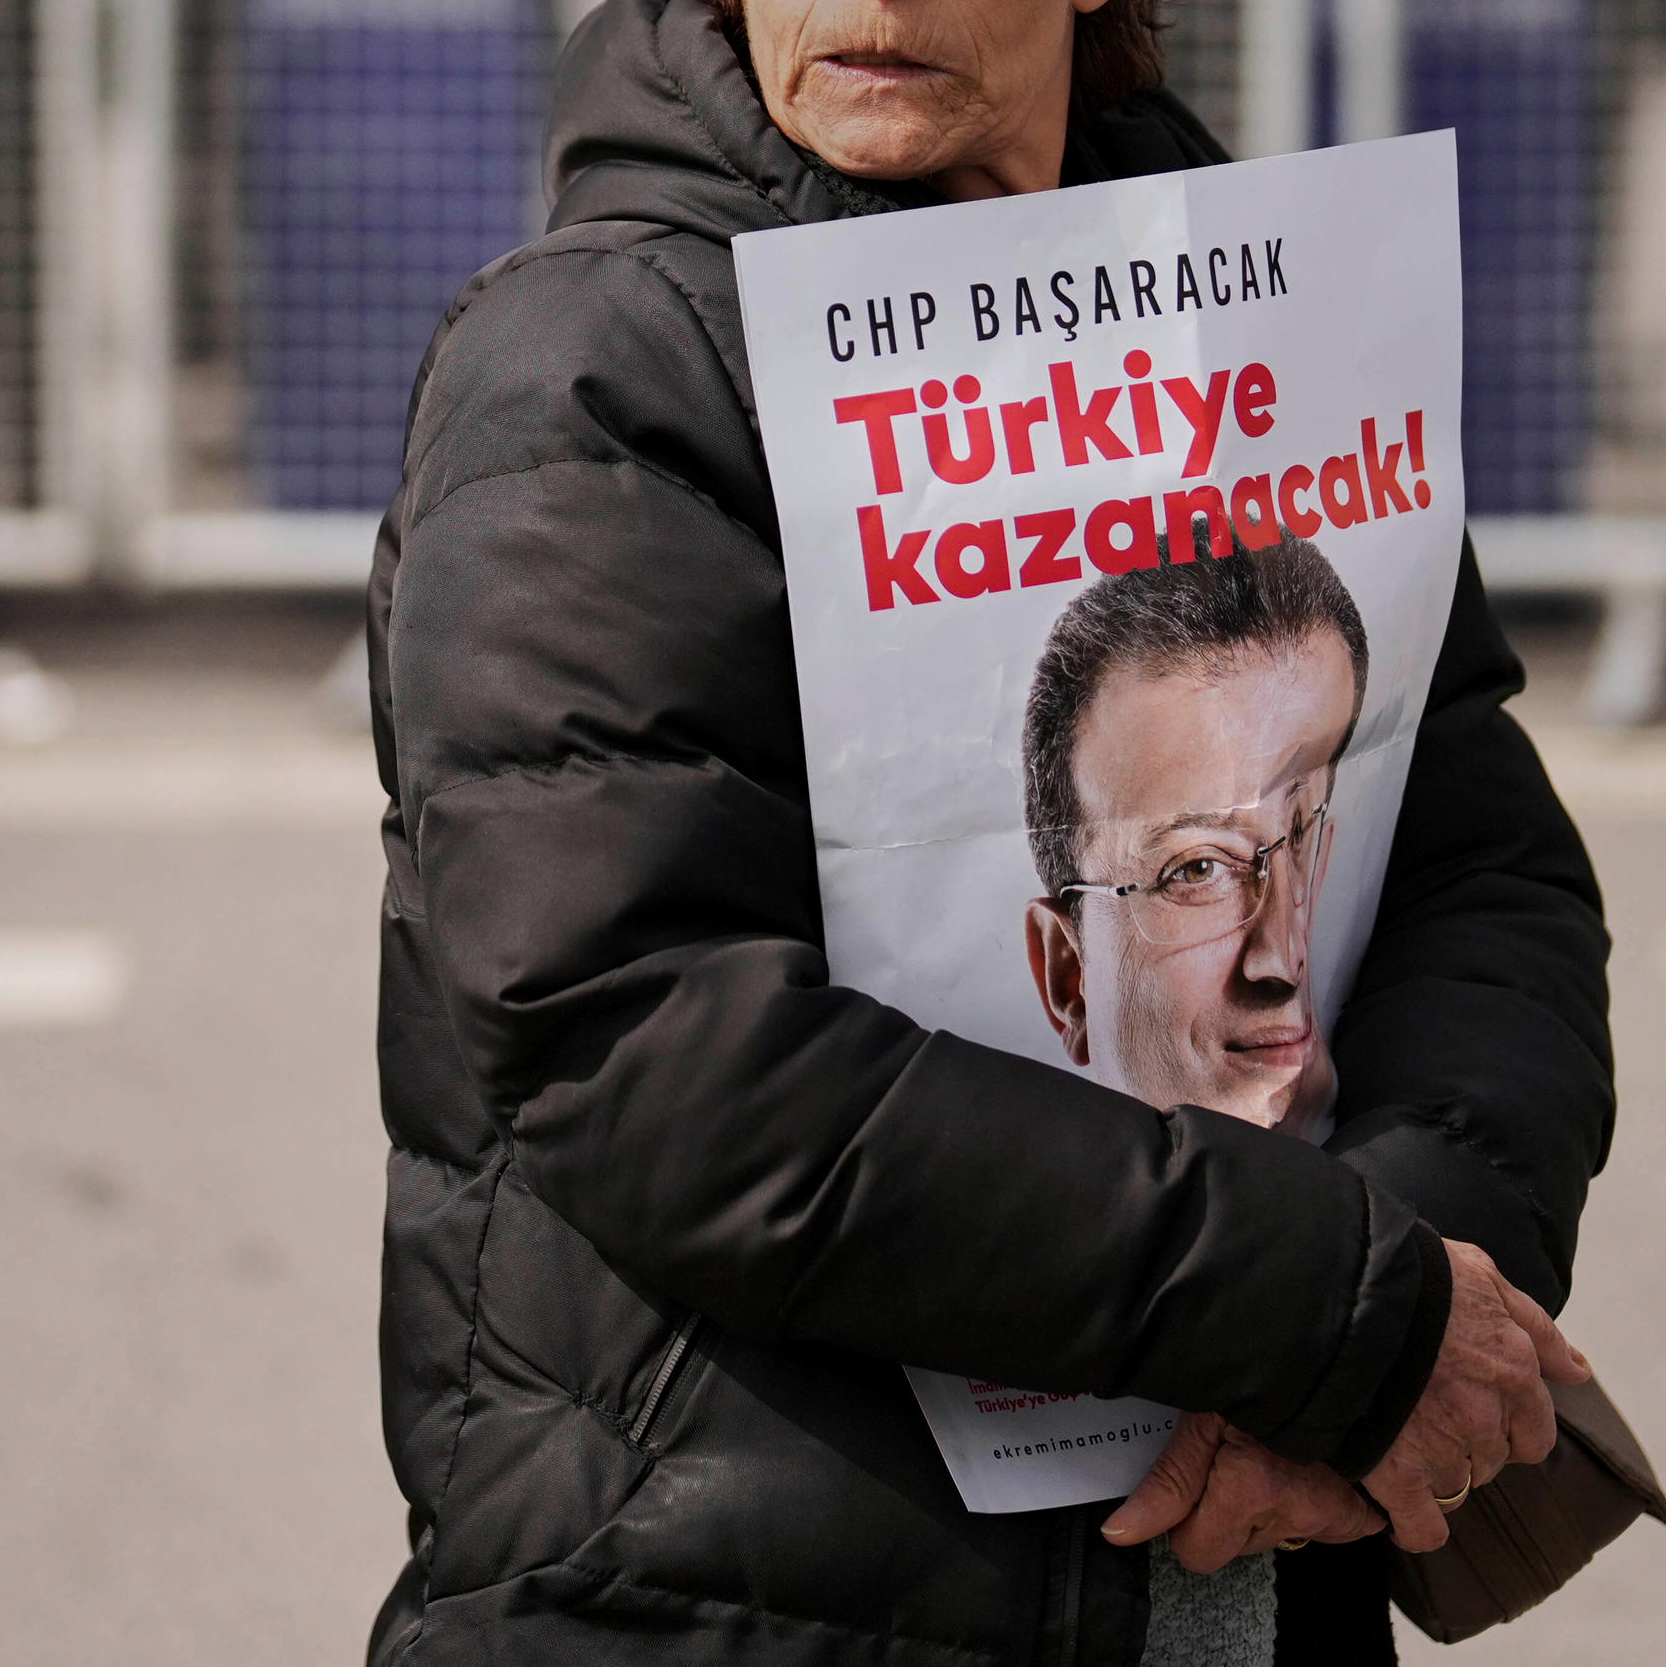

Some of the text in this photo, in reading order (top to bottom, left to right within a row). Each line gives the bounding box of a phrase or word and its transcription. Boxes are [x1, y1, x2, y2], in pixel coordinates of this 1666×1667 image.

[826, 237, 1289, 363] CHP BAŞARACAK
[833, 349, 1277, 495] Türkiye
[856, 409, 1432, 612] kazanacak!
